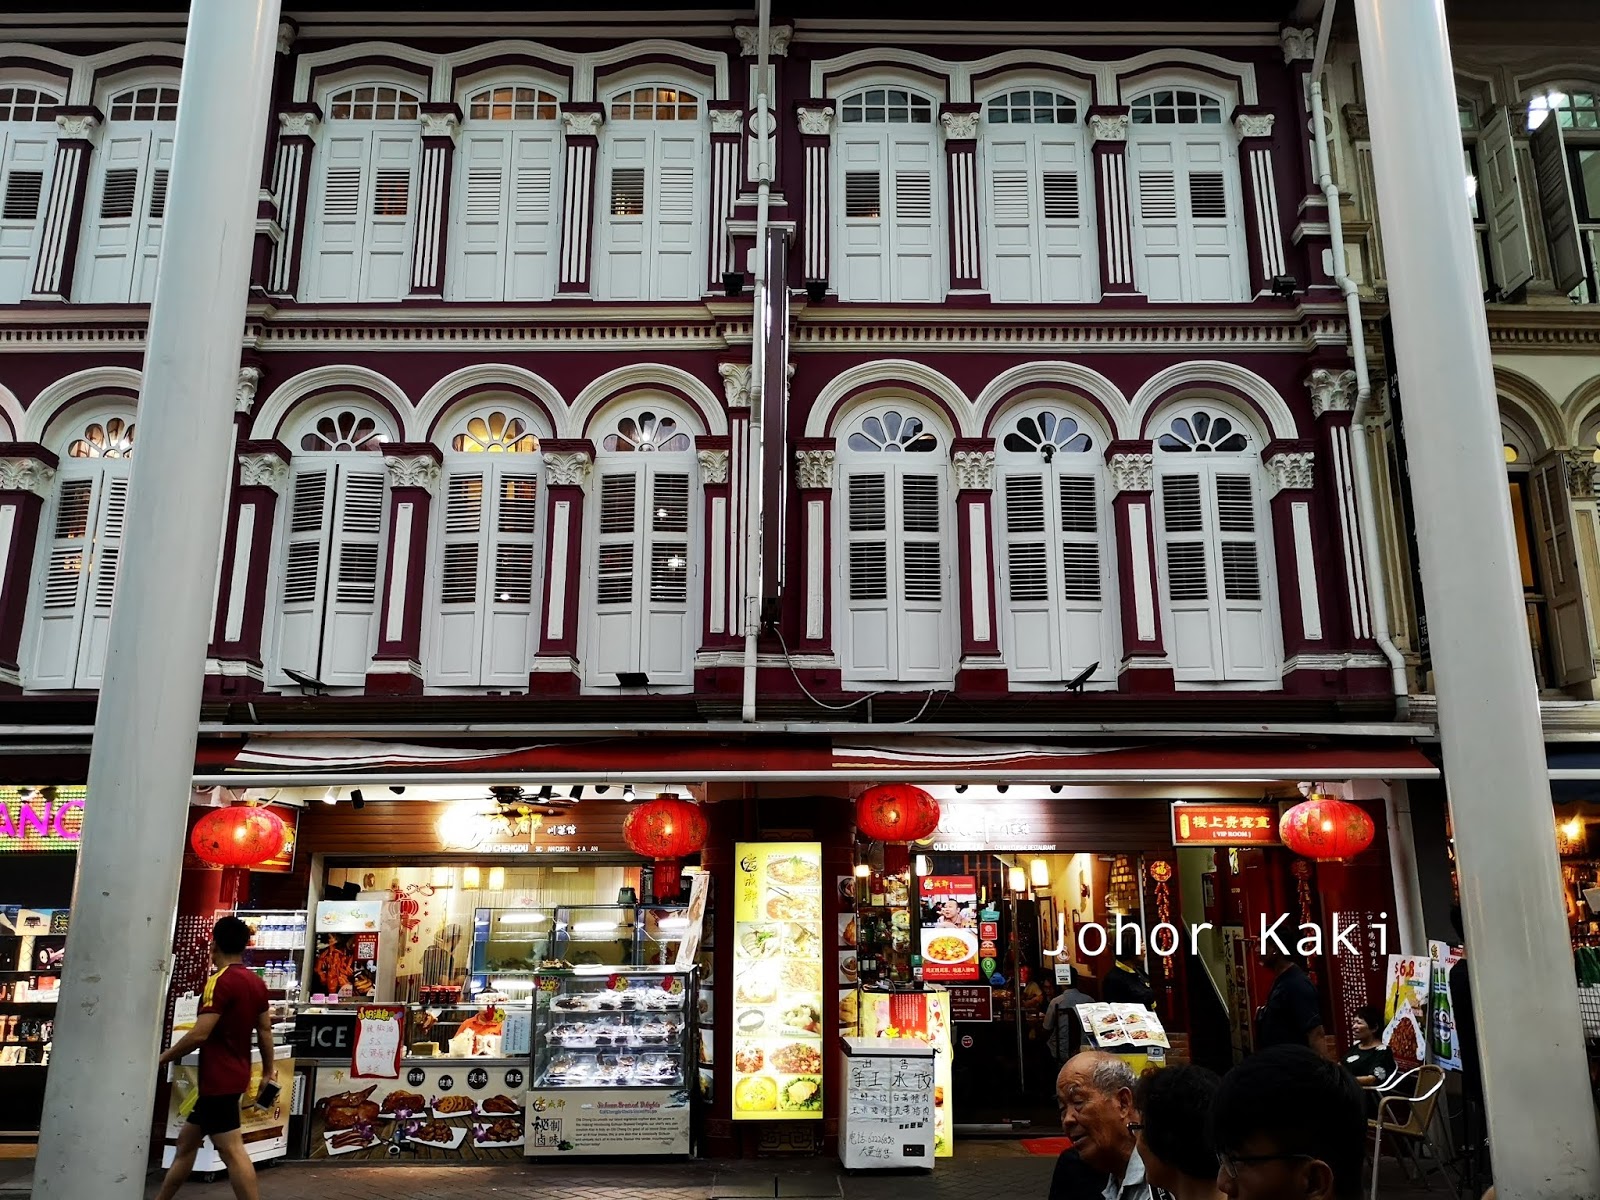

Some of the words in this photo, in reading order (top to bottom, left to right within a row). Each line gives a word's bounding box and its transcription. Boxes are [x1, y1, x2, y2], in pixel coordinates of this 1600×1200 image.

[1192, 815, 1271, 829] 楼上贵宾室
[311, 1026, 347, 1047] ICE
